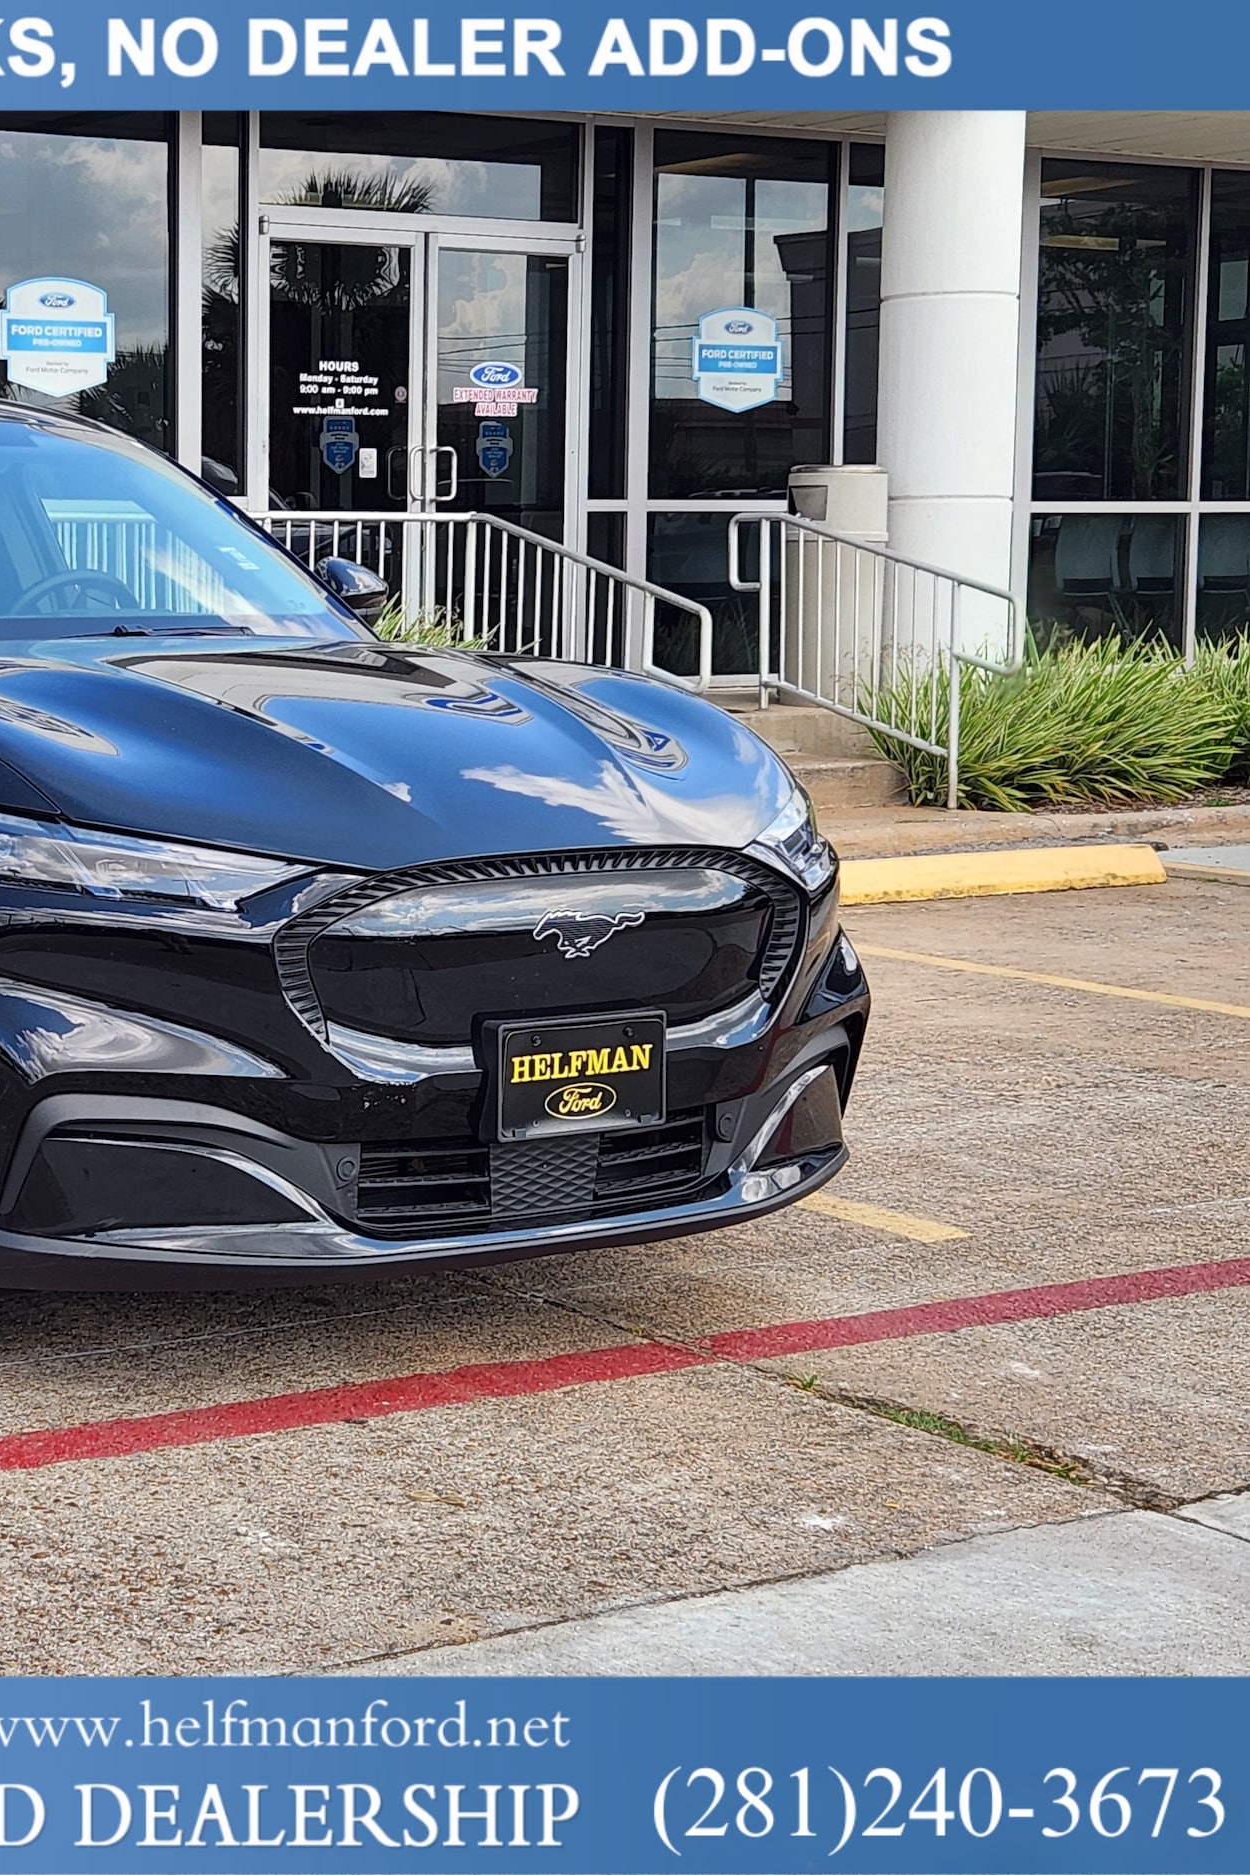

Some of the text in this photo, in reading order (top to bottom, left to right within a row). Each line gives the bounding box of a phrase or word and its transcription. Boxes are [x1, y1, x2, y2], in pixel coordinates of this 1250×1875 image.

[44, 295, 70, 307] Ford
[11, 324, 103, 338] FORD CERTIFIED
[728, 322, 748, 333] Ford
[32, 338, 83, 348] PRE-OWNED
[701, 349, 774, 360] FORD CERTIFIED
[60, 367, 89, 375] Company
[319, 361, 360, 372] HOURS
[299, 373, 333, 385] Monday
[340, 374, 379, 386] Saturday
[481, 367, 511, 383] Ford
[299, 384, 319, 394] 9:00
[321, 386, 336, 394] am
[342, 385, 363, 395] 9:00
[364, 388, 379, 397] pm
[454, 388, 537, 402] EXTENDED WARRANTY
[292, 406, 389, 416] www.helfmanford.com
[475, 403, 517, 415] AVAILABLE
[510, 1044, 653, 1083] HELFMAN
[559, 1087, 603, 1114] Ford
